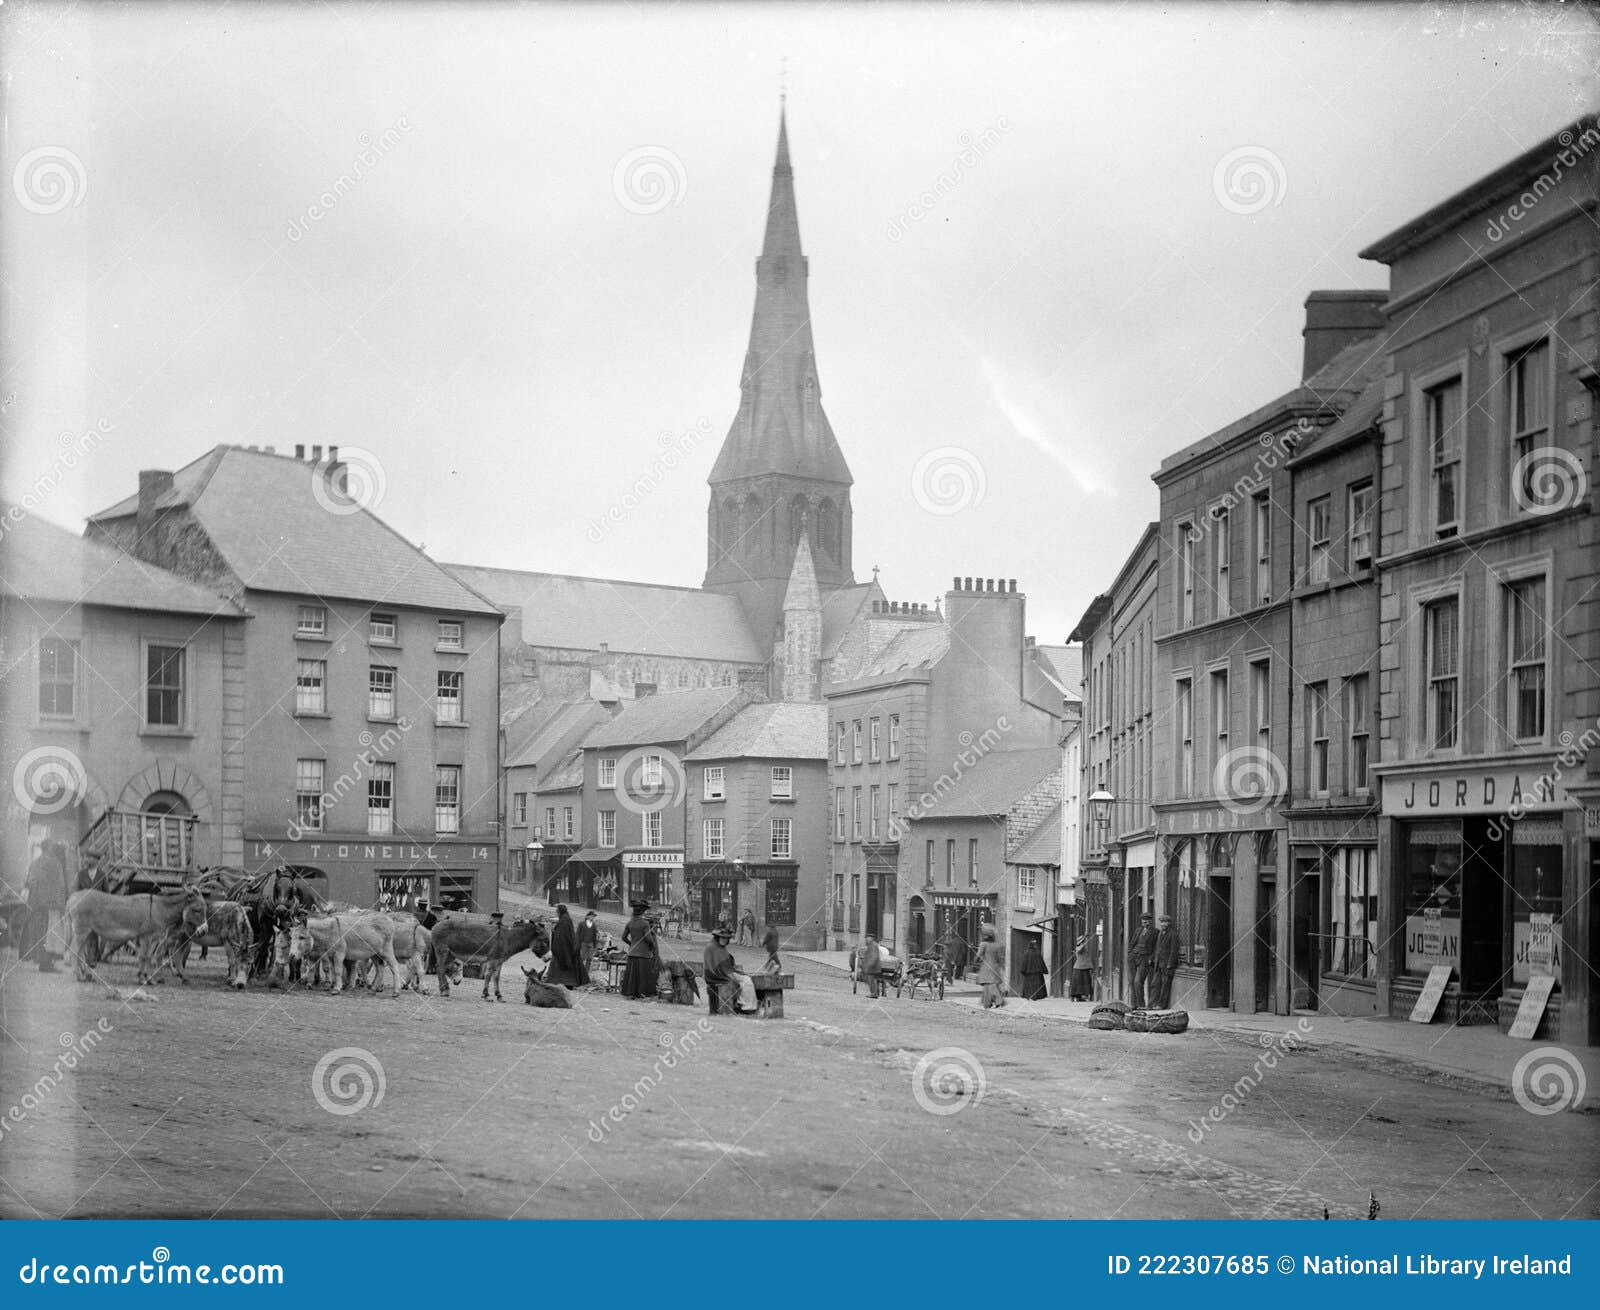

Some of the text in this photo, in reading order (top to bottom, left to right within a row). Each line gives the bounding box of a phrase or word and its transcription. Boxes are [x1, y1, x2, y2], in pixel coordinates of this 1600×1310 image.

[255, 843, 273, 857] 14
[471, 847, 489, 860] 14
[1409, 932, 1457, 957] JOAN
